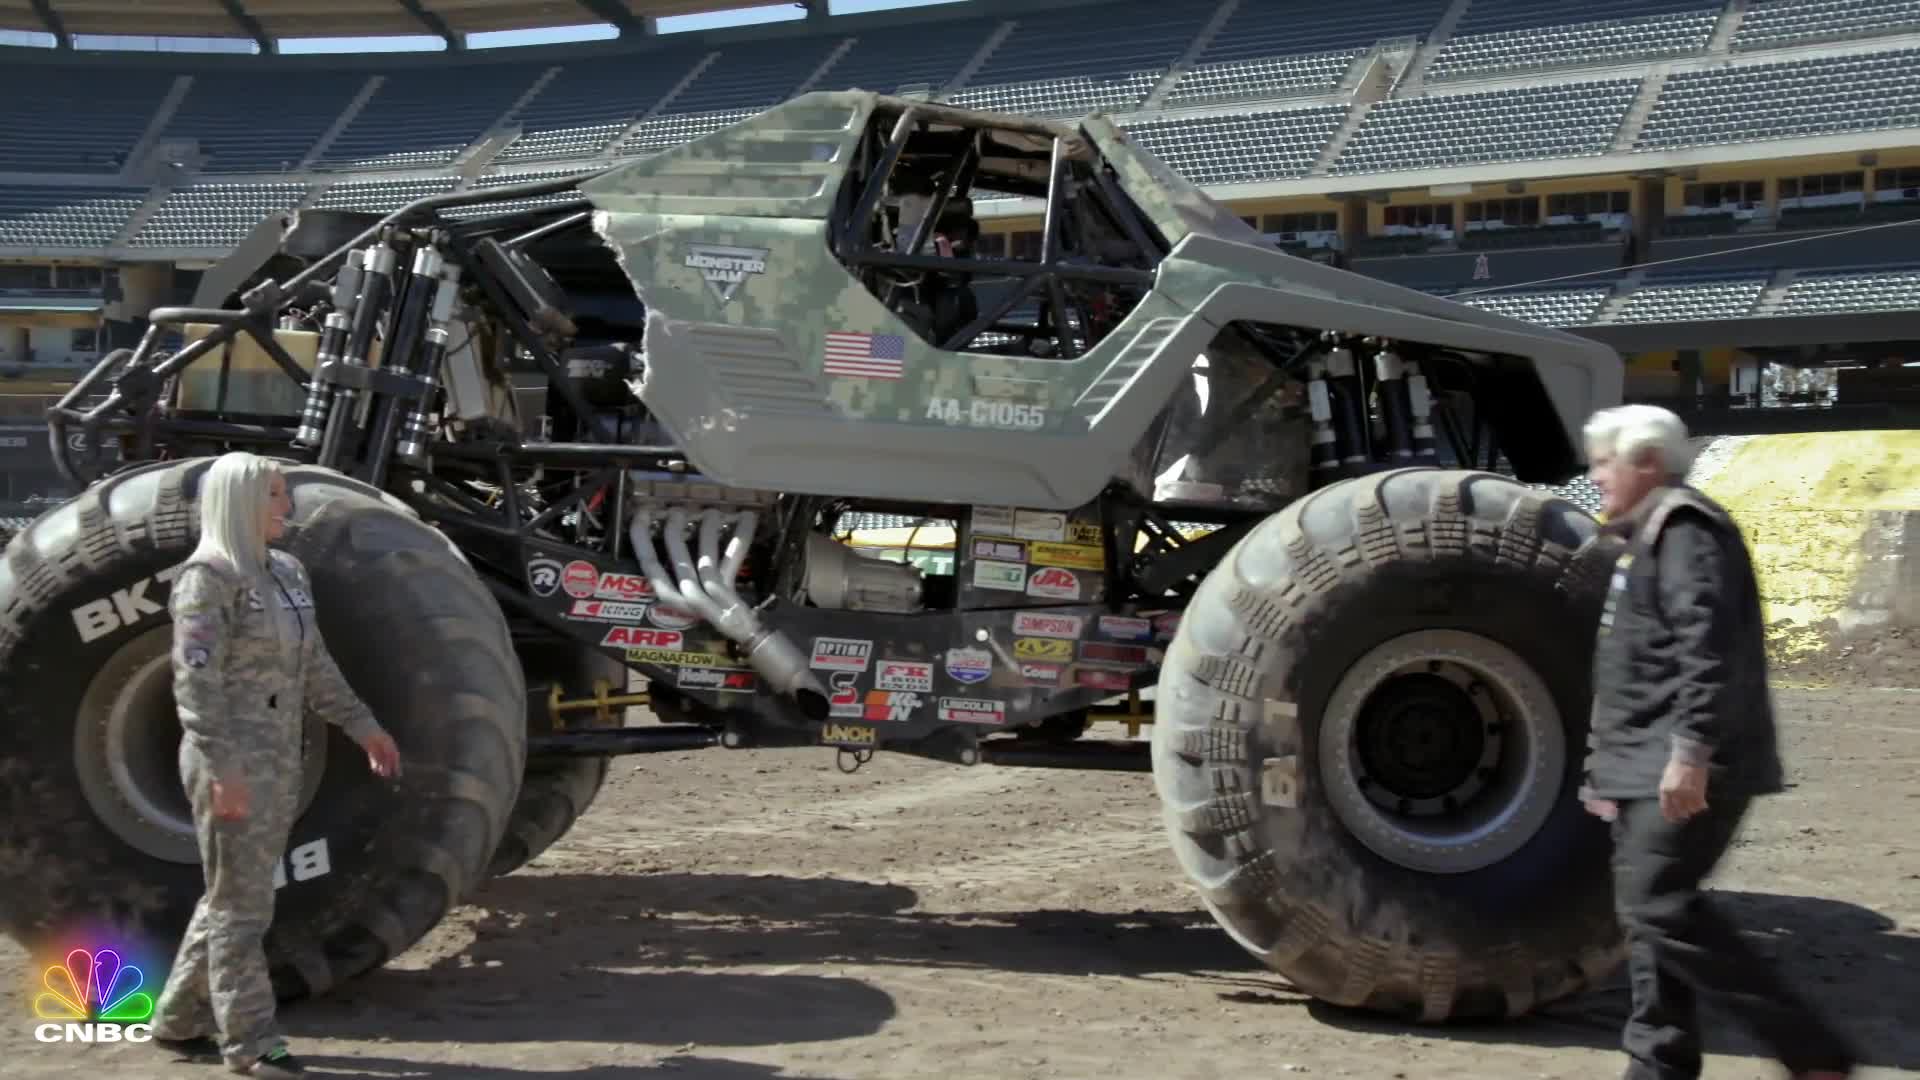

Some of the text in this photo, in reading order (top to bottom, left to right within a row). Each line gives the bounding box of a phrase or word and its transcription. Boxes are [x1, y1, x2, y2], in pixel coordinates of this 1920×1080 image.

[685, 254, 765, 274] MONSTER
[705, 268, 743, 283] JAM
[926, 398, 1045, 428] AA-C1055
[601, 603, 641, 618] KING
[1021, 615, 1075, 634] SIMPSON
[607, 627, 681, 647] ARP
[628, 650, 714, 666] MAGNAFLOW
[819, 642, 866, 657] OPTIMA
[822, 723, 875, 743] UNOH
